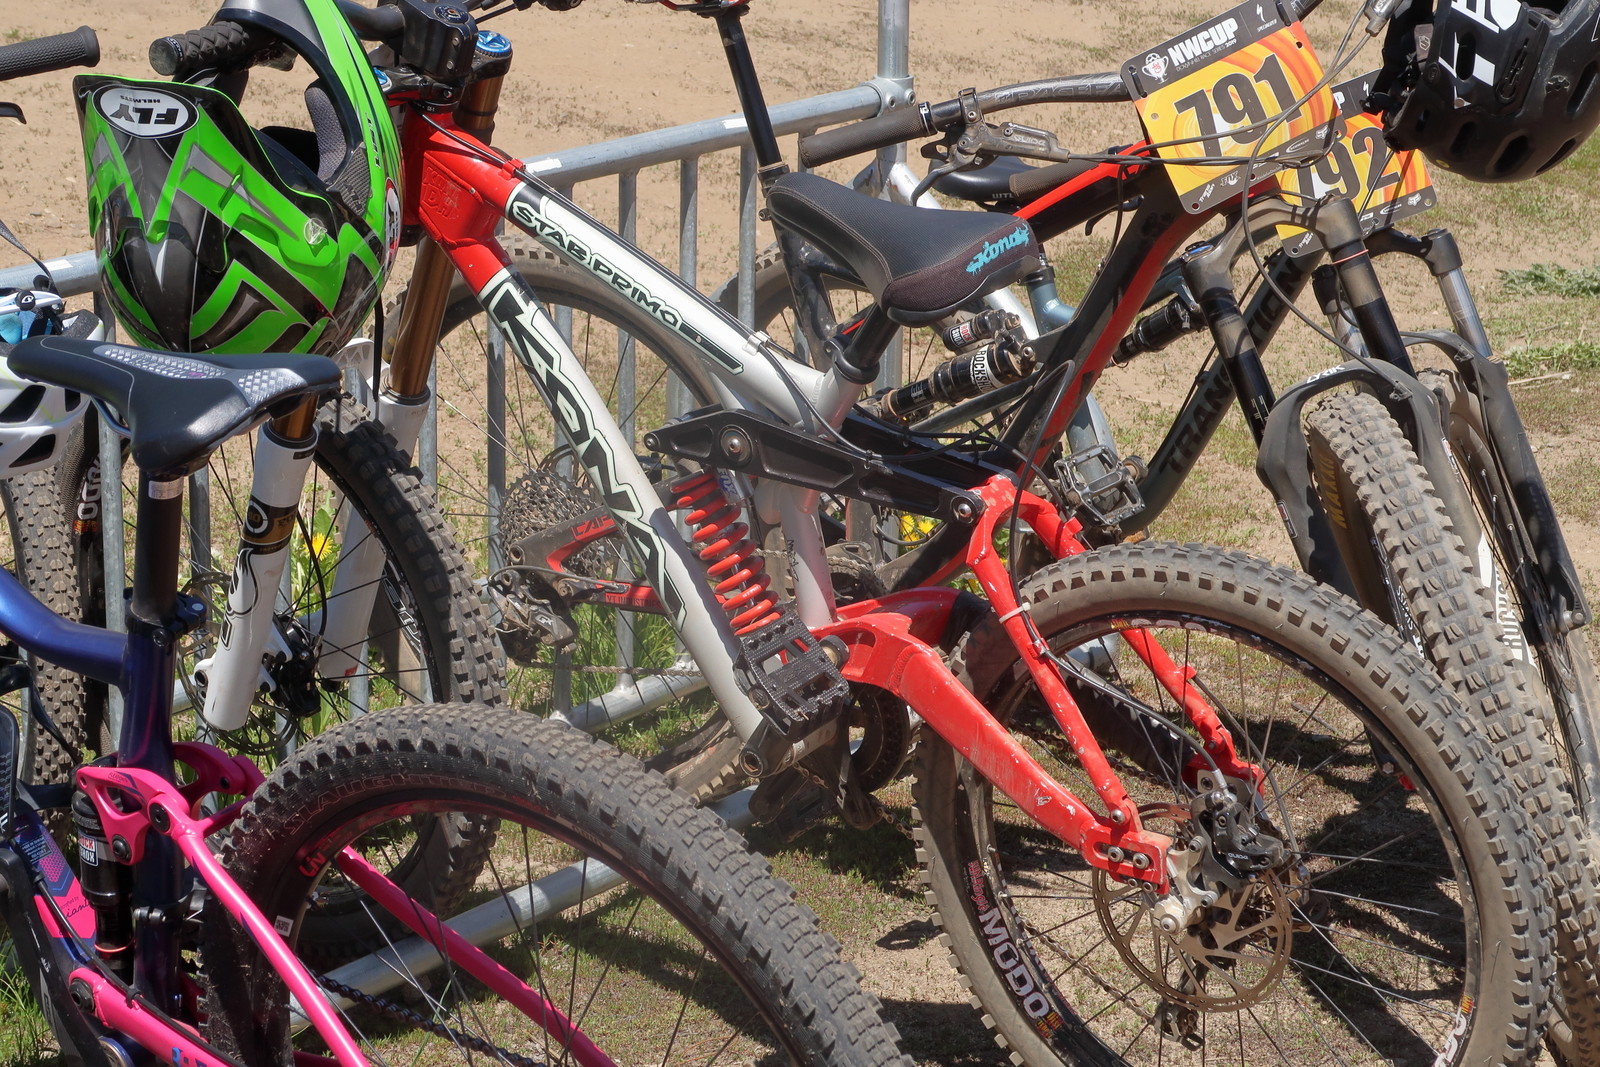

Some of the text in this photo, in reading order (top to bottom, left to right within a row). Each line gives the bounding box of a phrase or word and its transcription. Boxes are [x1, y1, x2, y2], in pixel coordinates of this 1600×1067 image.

[1168, 18, 1239, 67] NWCUP
[1225, 38, 1237, 48] 2019
[109, 103, 180, 125] FLY
[119, 94, 161, 104] HELMETS
[1173, 53, 1302, 158] 791
[1220, 170, 1241, 187] FOX
[513, 201, 682, 330] STAB PRIMO
[965, 223, 1030, 276] Kona
[960, 323, 974, 342] ROCK
[974, 348, 994, 394] ROCKSHO
[1306, 365, 1346, 384] LYRIK
[489, 282, 686, 630] KONA
[1397, 585, 1415, 630] SWISS
[283, 773, 508, 836] SLAUGHTER
[298, 850, 327, 878] Liv
[979, 907, 1050, 1020] MODO
